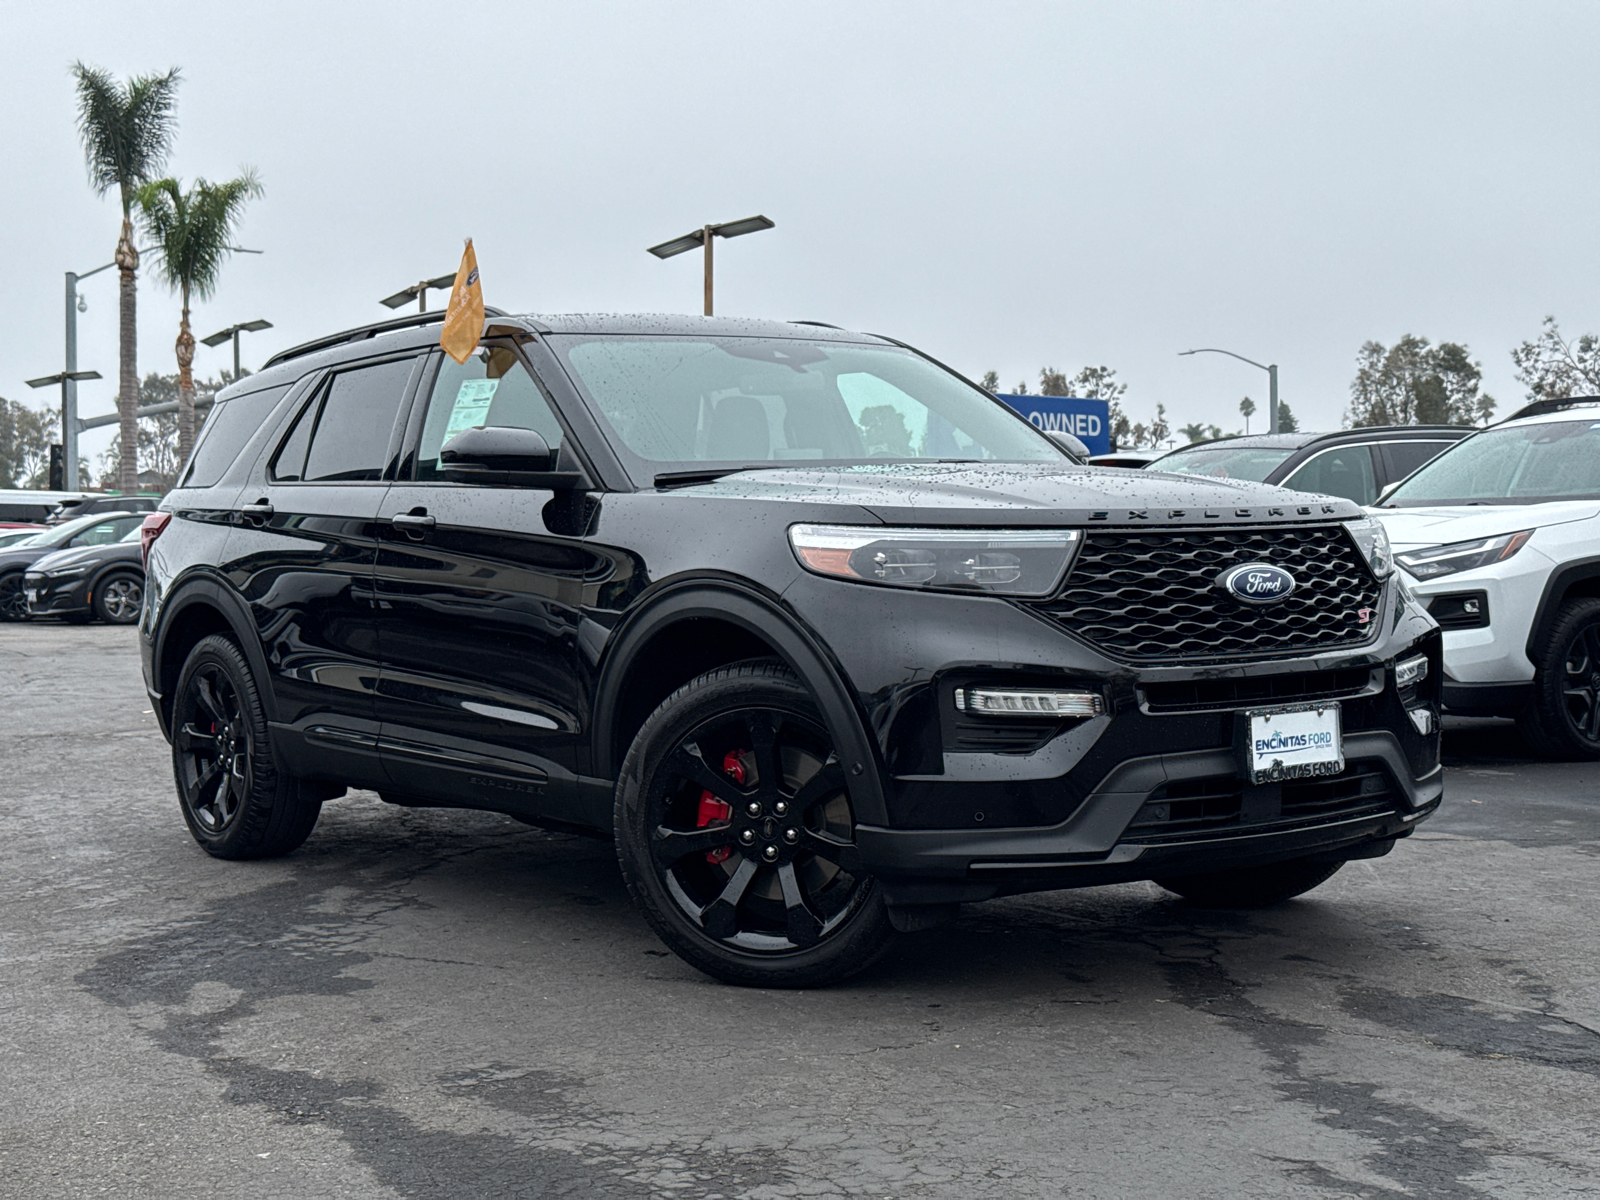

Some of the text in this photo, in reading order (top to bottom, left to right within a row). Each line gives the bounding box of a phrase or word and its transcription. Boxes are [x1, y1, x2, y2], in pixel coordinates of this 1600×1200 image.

[1029, 411, 1101, 436] OWNED
[1088, 505, 1336, 521] EXPLORER
[1246, 572, 1282, 594] Ford
[1255, 732, 1332, 752] ENCINITAS FORD
[1255, 760, 1340, 783] ENCINITAS FORD
